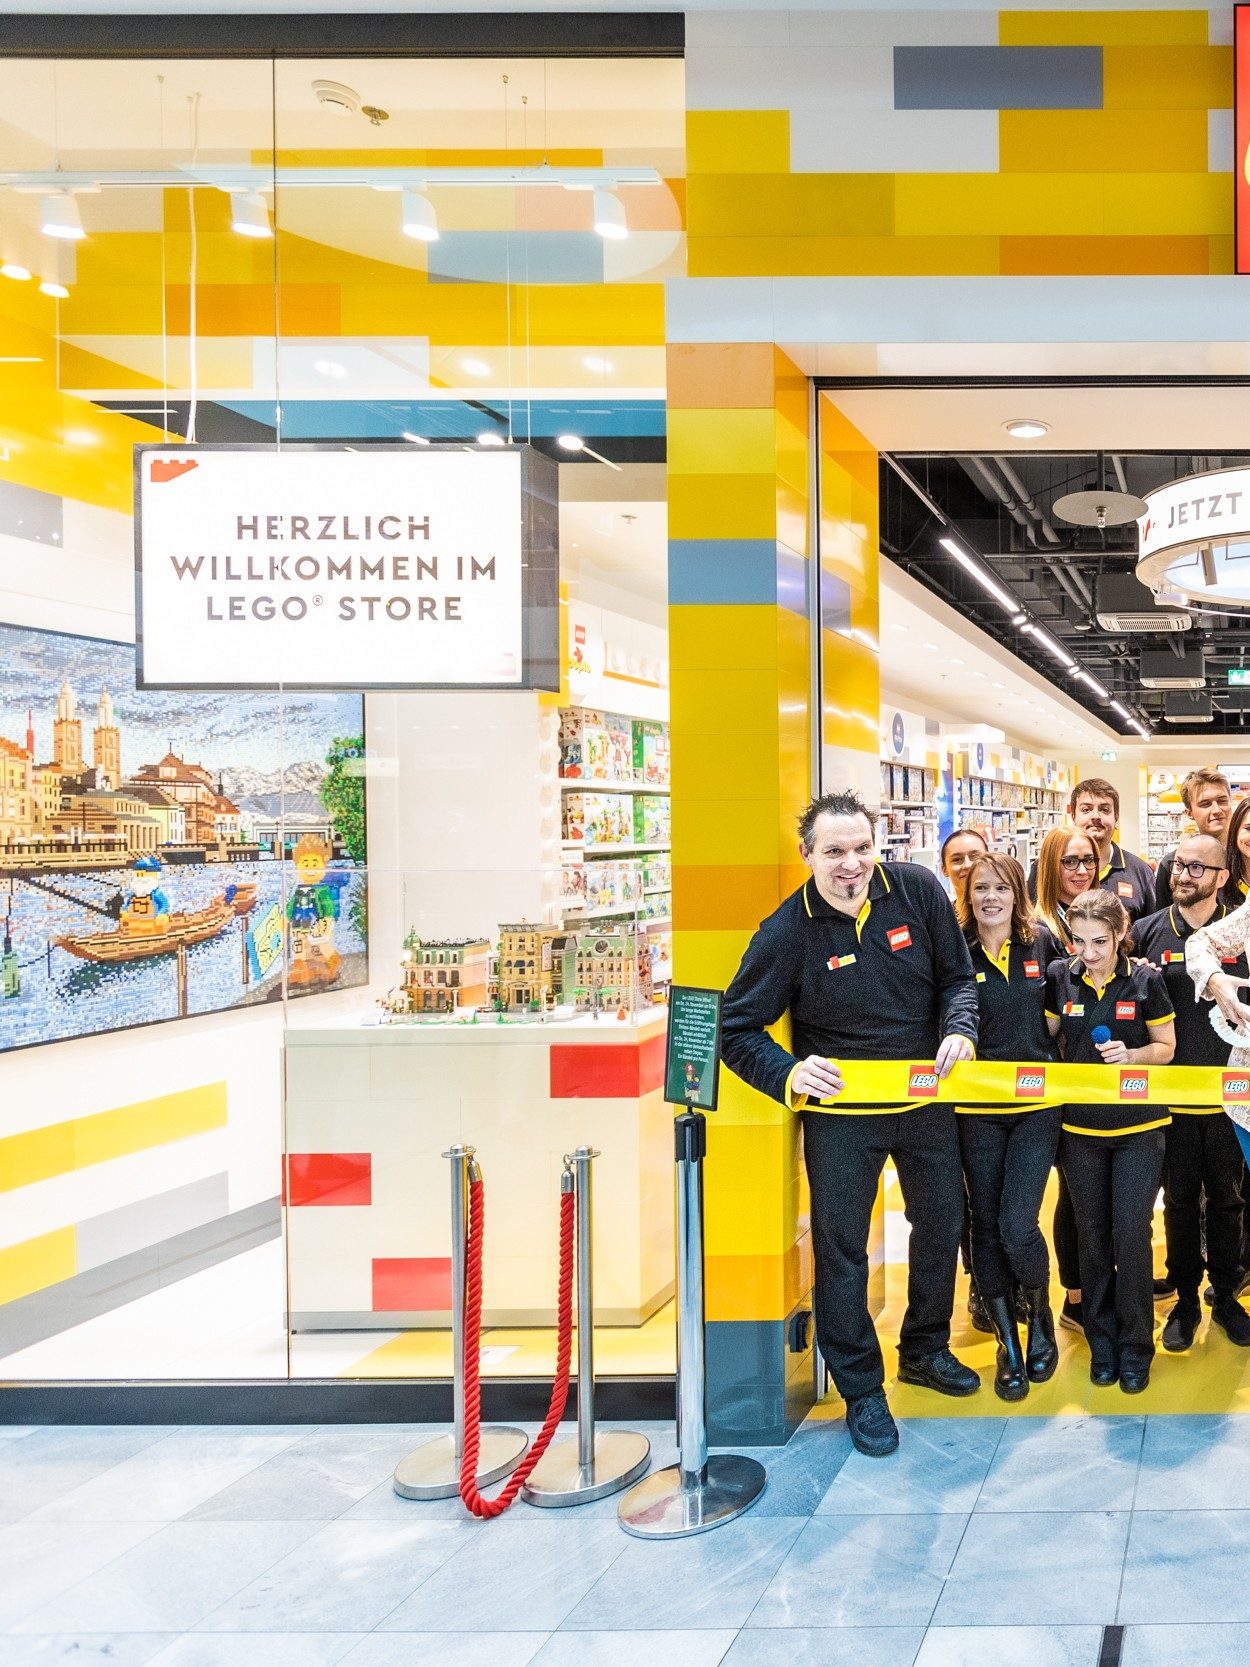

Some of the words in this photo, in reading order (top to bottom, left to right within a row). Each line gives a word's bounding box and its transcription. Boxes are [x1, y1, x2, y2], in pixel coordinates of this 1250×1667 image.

[1167, 491, 1242, 529] JETZT
[236, 515, 430, 540] HERZLICH
[169, 555, 438, 581] WILLKOMMEN
[457, 555, 496, 581] IM
[338, 596, 462, 621] STORE
[910, 1074, 938, 1087] LEGO
[1017, 1075, 1044, 1089] LEGO
[1121, 1077, 1147, 1091] LEGO
[1223, 1080, 1249, 1093] LEGO
